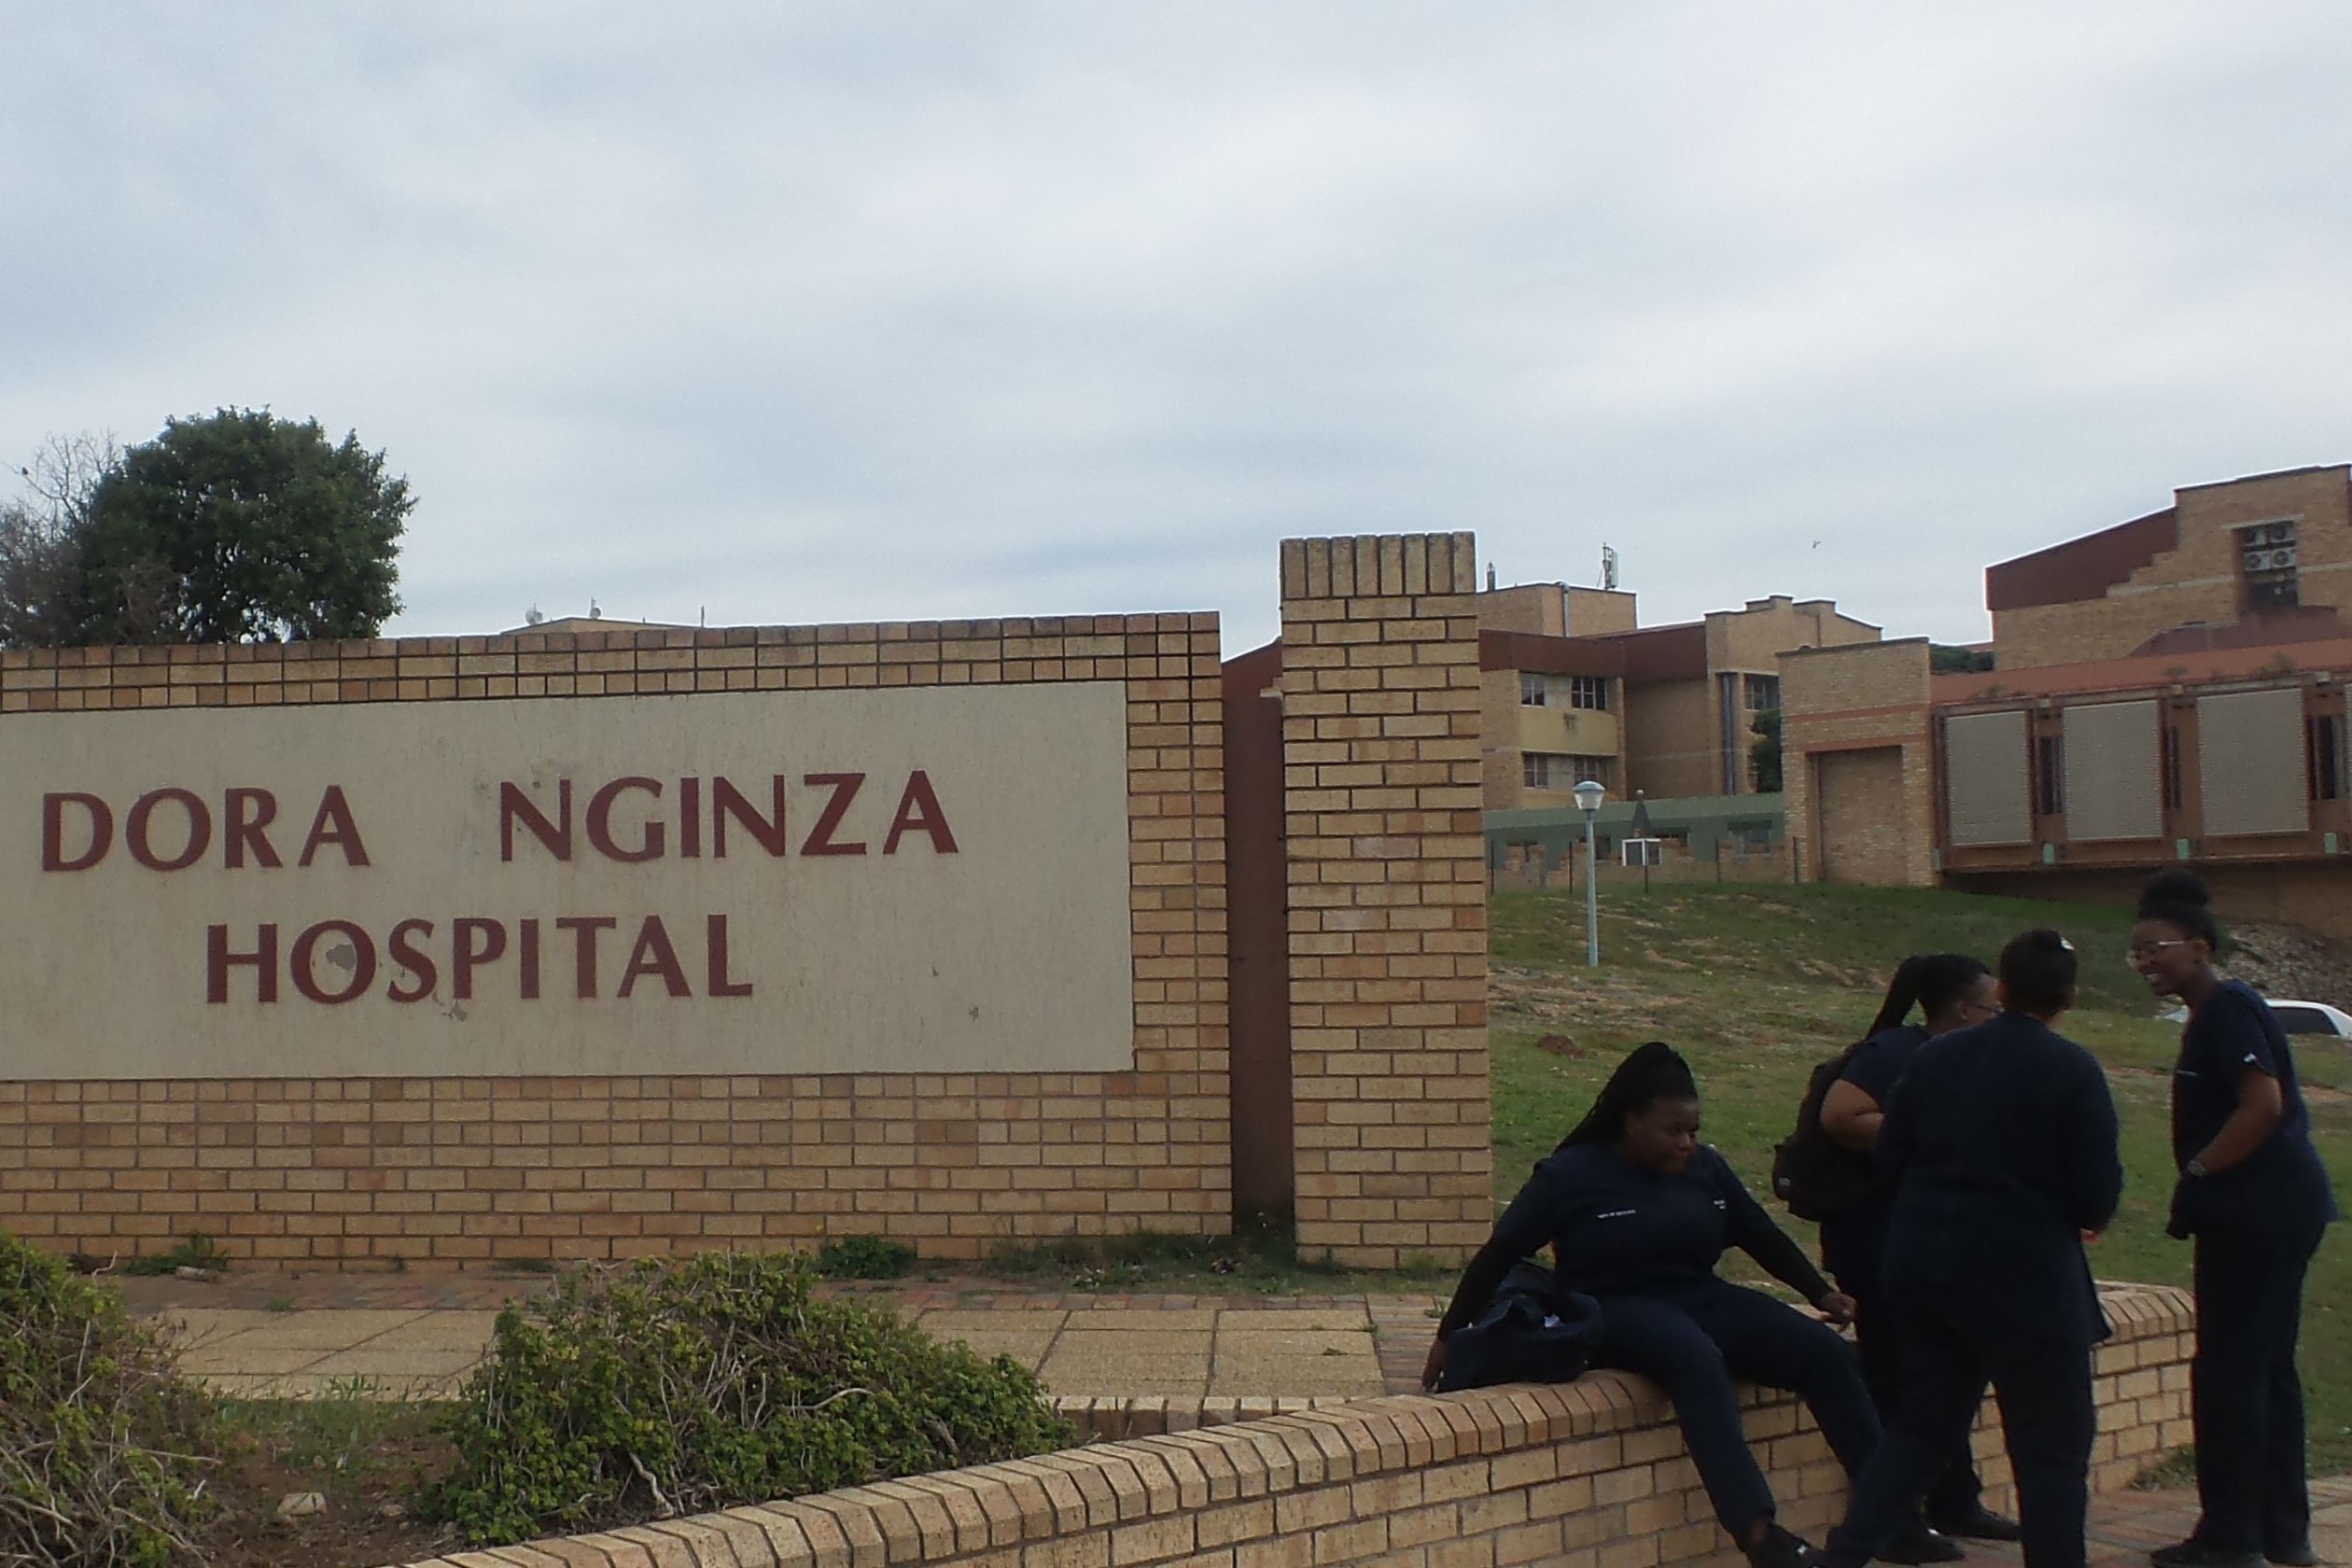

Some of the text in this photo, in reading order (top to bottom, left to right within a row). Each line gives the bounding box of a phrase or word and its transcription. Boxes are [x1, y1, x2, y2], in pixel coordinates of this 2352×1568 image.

[42, 770, 959, 872] DORA NGINZA
[206, 914, 753, 1005] HOSPITAL
